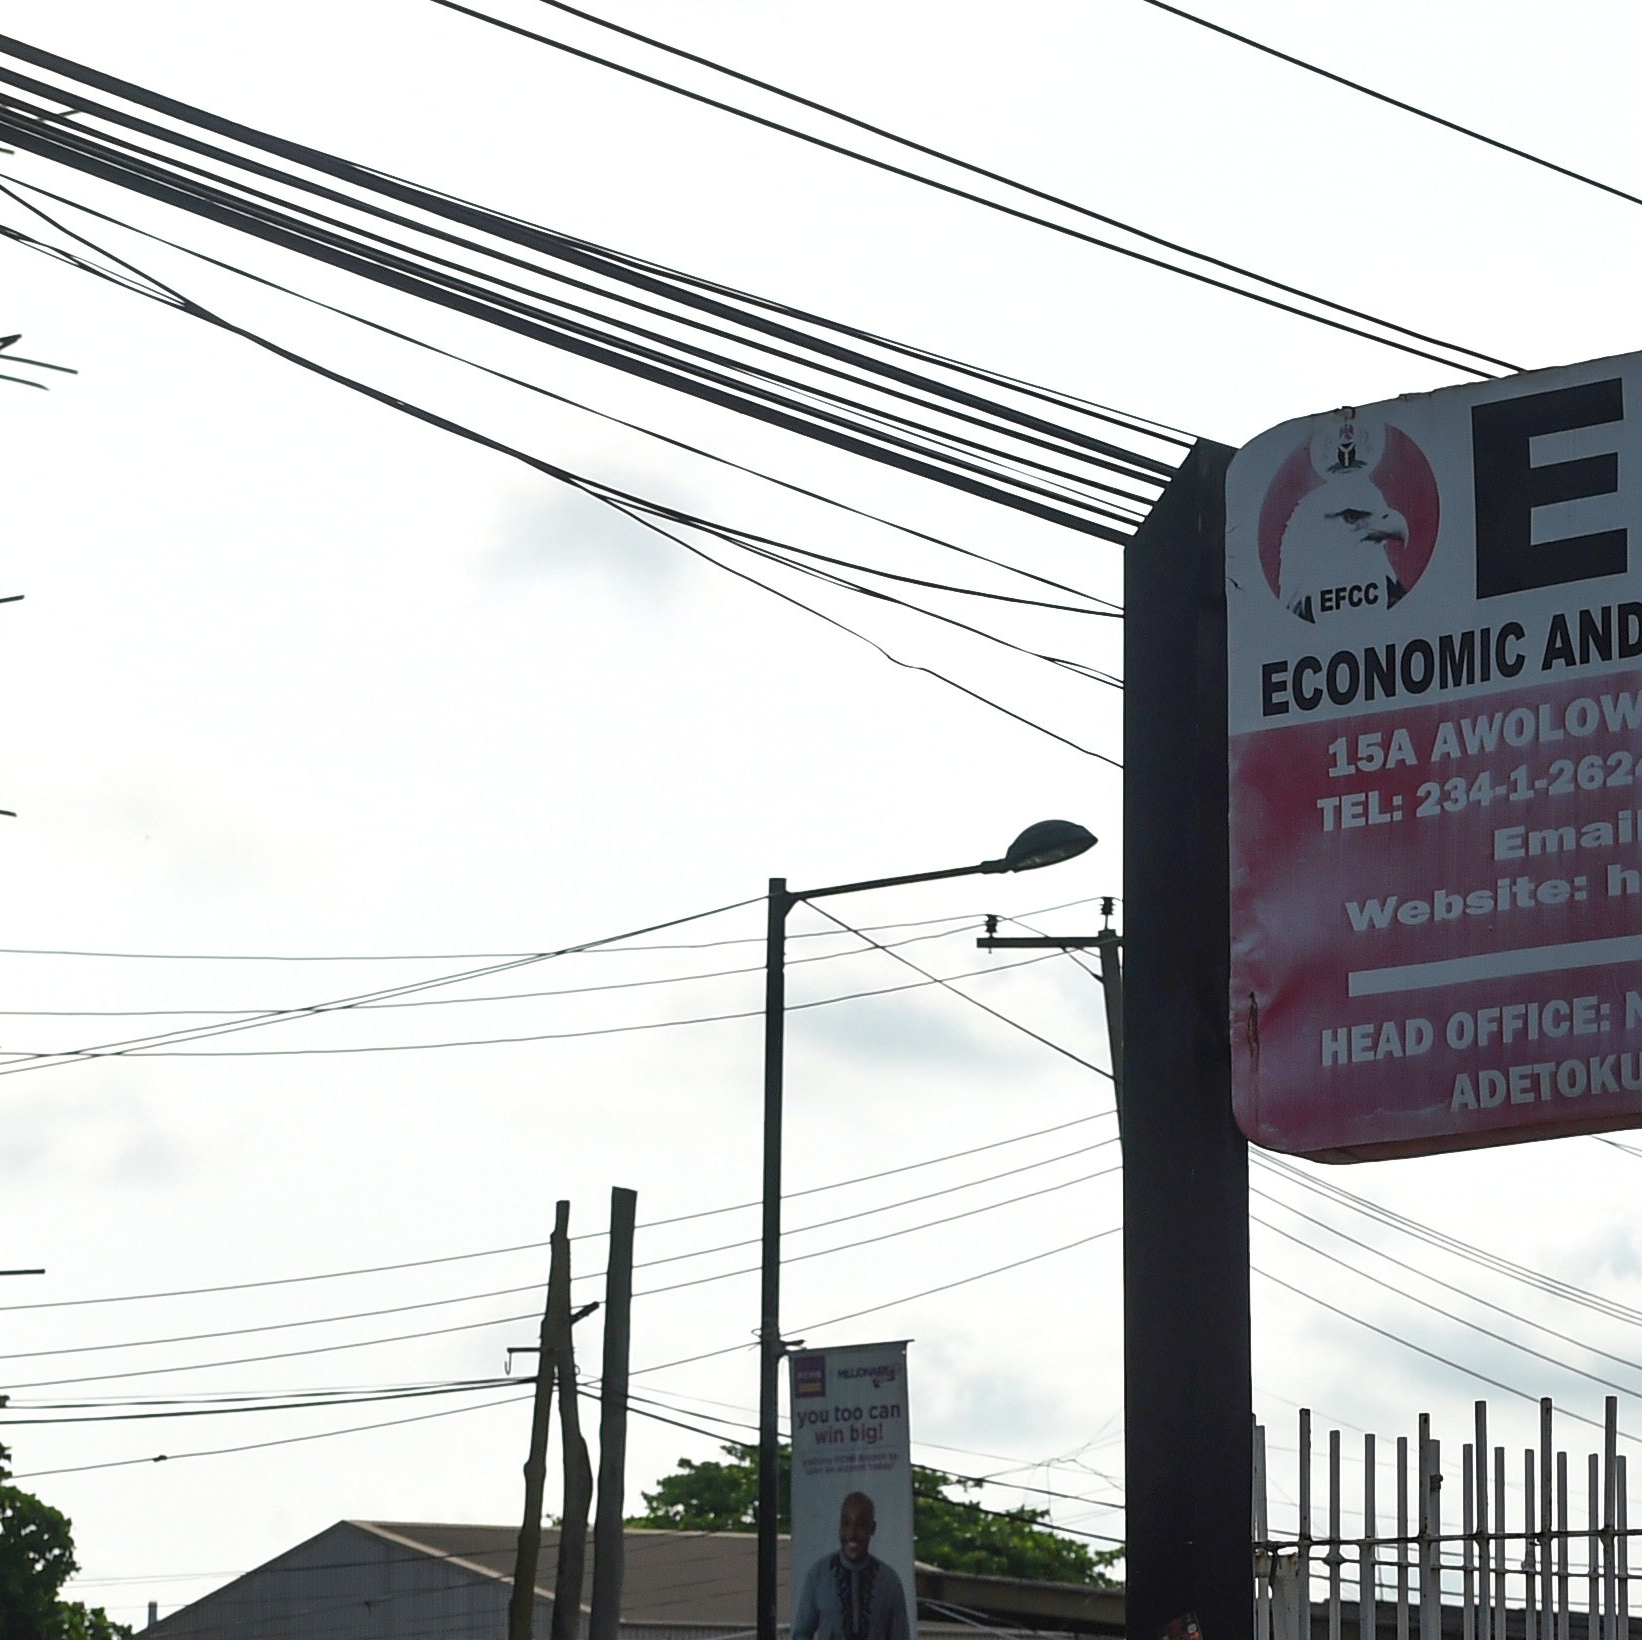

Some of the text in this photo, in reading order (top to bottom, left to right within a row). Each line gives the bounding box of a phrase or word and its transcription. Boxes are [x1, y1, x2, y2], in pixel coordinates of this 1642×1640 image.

[1319, 581, 1380, 613] EFCC
[1261, 621, 1527, 718] ECONOMIC
[1327, 736, 1419, 779] 15A
[1315, 789, 1404, 832] TEL:
[1345, 872, 1588, 932] Website:
[1320, 1017, 1434, 1068] HEAD
[1445, 994, 1612, 1051] OFFICE:
[797, 1404, 901, 1429] you too can
[815, 1424, 884, 1444] win big!
